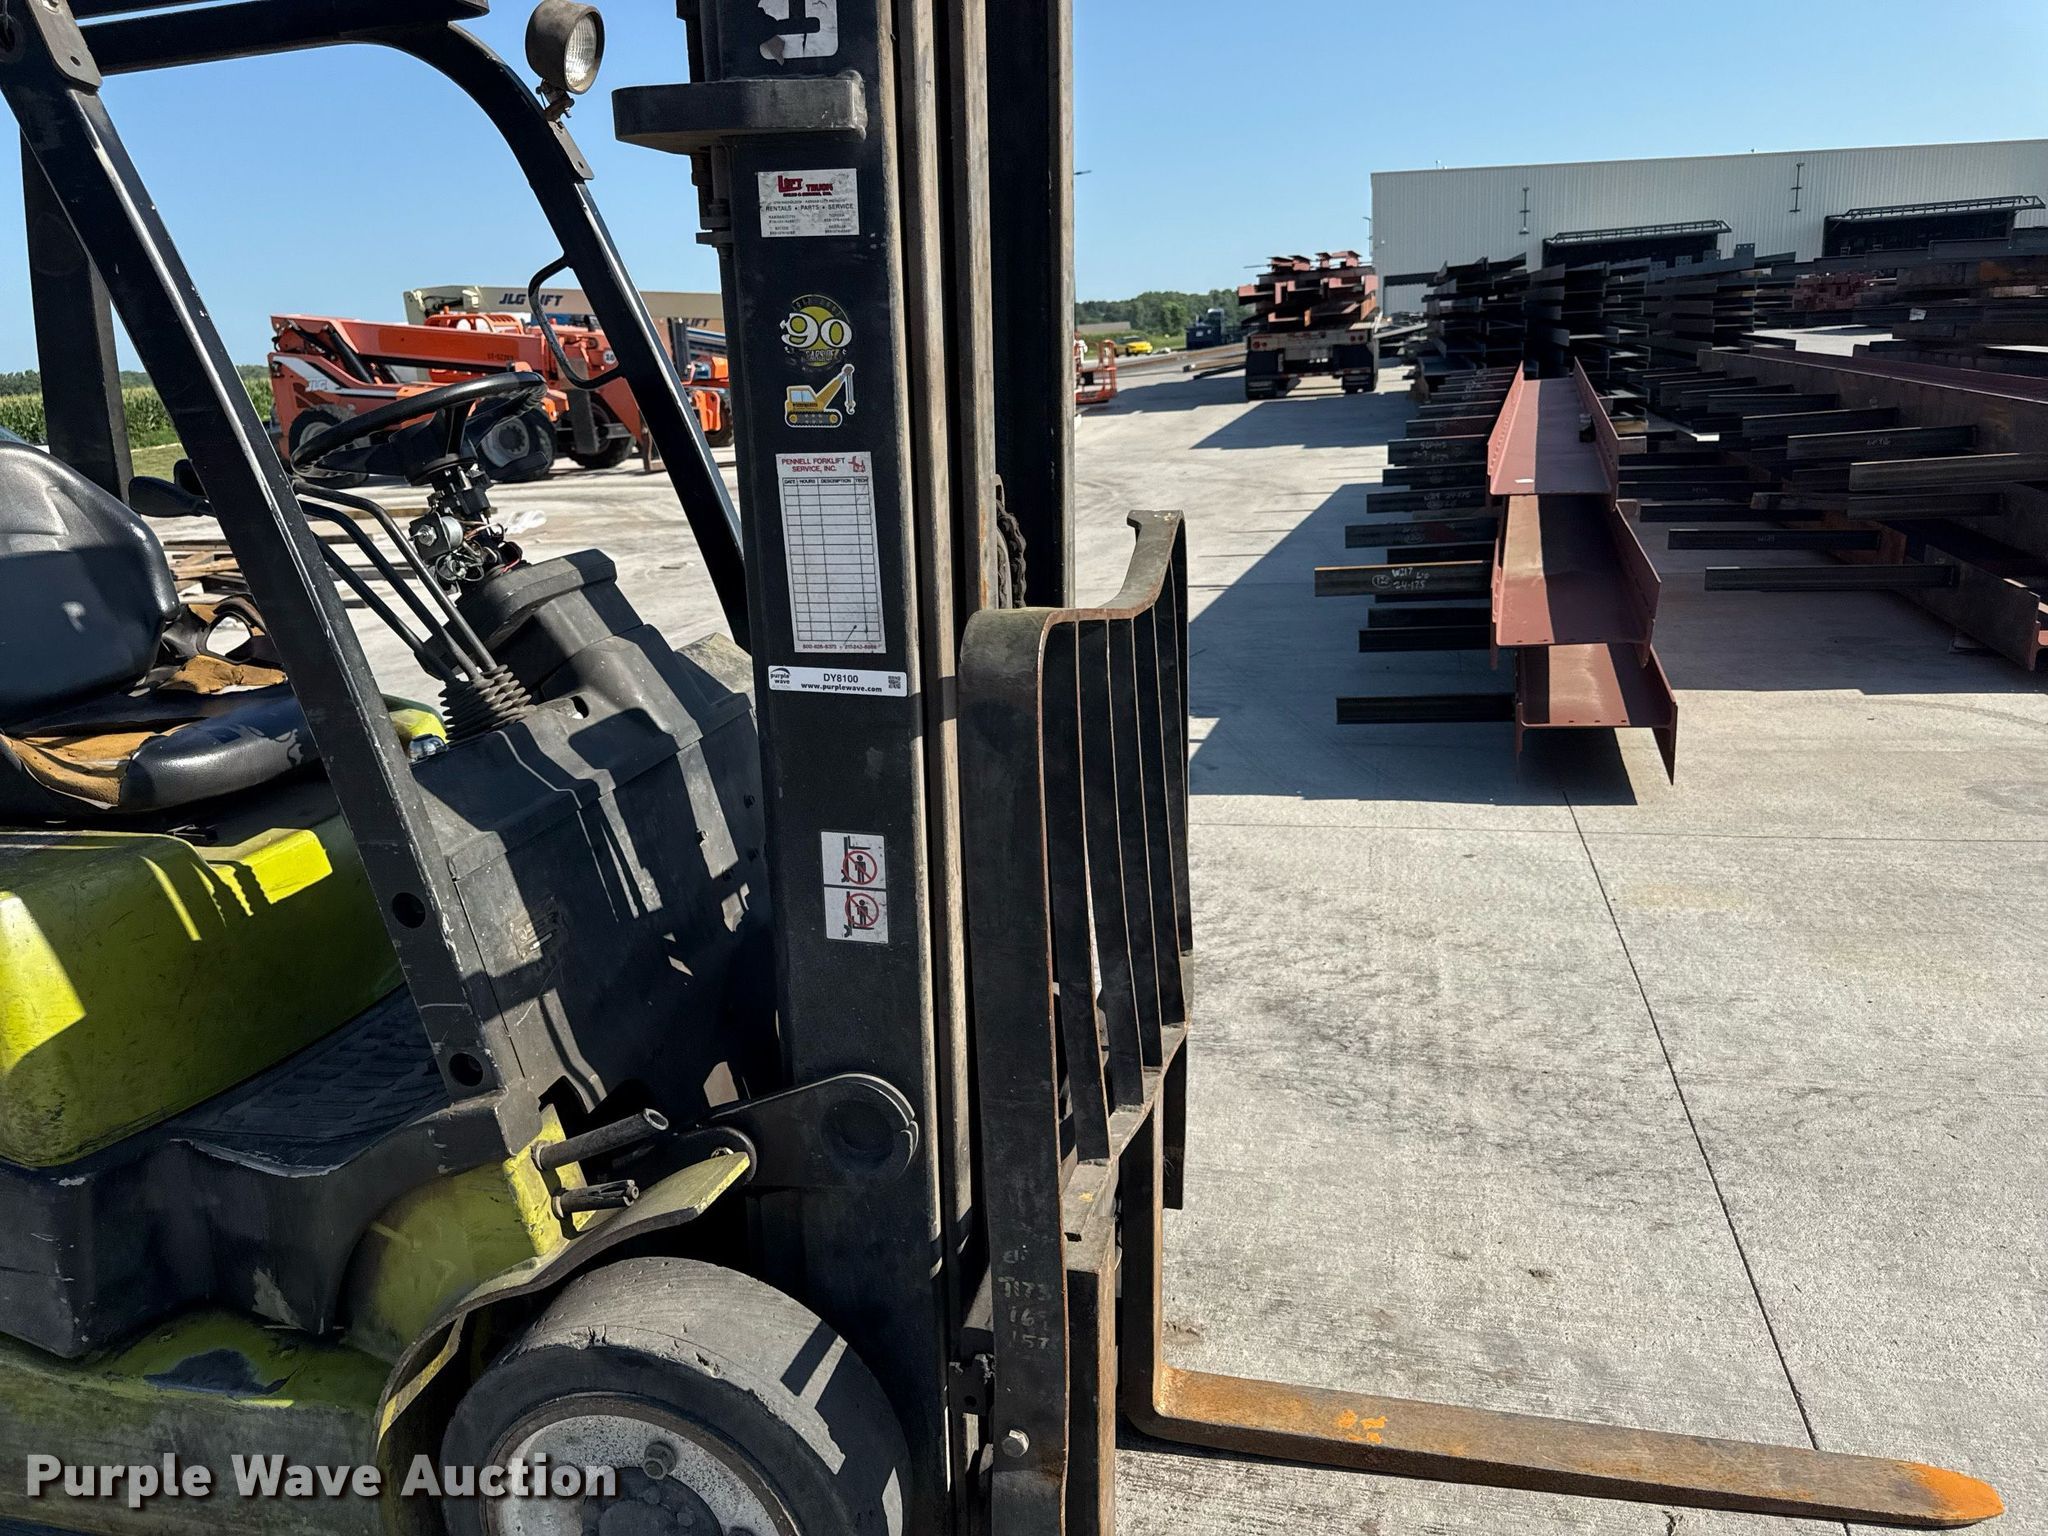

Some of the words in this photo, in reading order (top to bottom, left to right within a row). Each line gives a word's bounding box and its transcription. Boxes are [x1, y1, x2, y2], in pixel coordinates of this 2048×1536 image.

[499, 293, 526, 305] JLG
[780, 312, 852, 348] 90
[782, 457, 811, 465] PENNELL
[792, 465, 822, 473] SERVICE,
[823, 673, 859, 683] DY8100
[801, 683, 882, 693] www.purplewave.com
